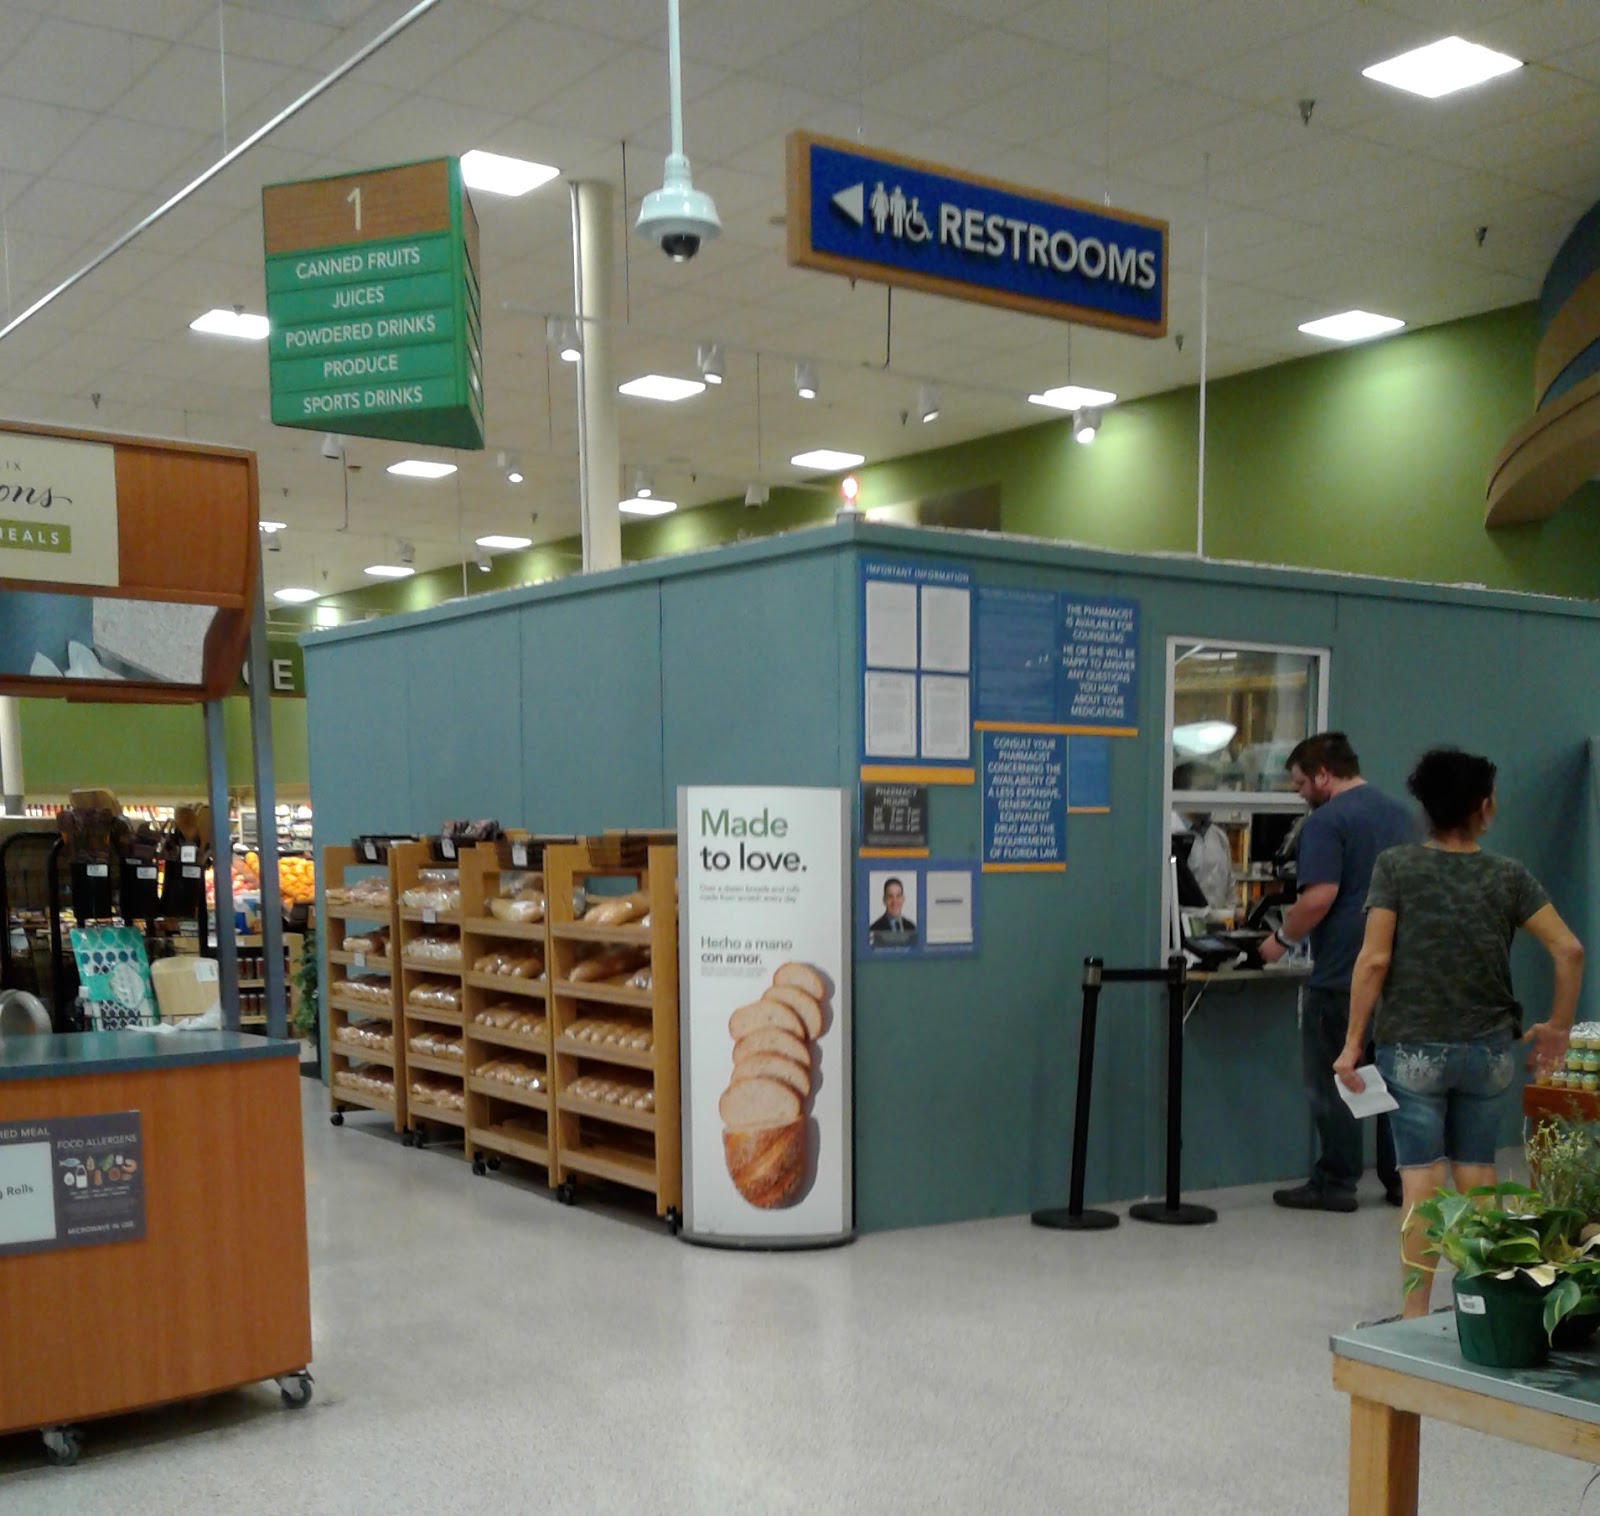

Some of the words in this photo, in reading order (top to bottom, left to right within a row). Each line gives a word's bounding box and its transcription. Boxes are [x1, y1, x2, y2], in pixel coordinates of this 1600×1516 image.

[346, 187, 362, 231] 1
[940, 202, 1156, 290] RESTROOMS
[296, 254, 364, 280] CANNED
[368, 246, 420, 269] FRUITS
[332, 286, 385, 309] JUICES
[286, 322, 373, 348] POWDERED
[378, 314, 436, 337] DRINKS
[324, 354, 398, 378] PRODUCE
[303, 392, 360, 414] SPORTS
[364, 386, 423, 408] DRINKS
[0, 527, 59, 545] EALS
[866, 563, 912, 578] IMPORTANT
[914, 568, 970, 584] INFORMATION
[701, 807, 788, 838] Made
[700, 846, 731, 872] to
[739, 841, 807, 872] love.
[701, 935, 741, 949] Hecho
[744, 940, 752, 949] a
[755, 939, 793, 951] mano
[701, 953, 723, 963] con
[20, 1127, 50, 1138] MEAL
[86, 1134, 138, 1146] ALLERGENS
[6, 1183, 34, 1196] Rolls
